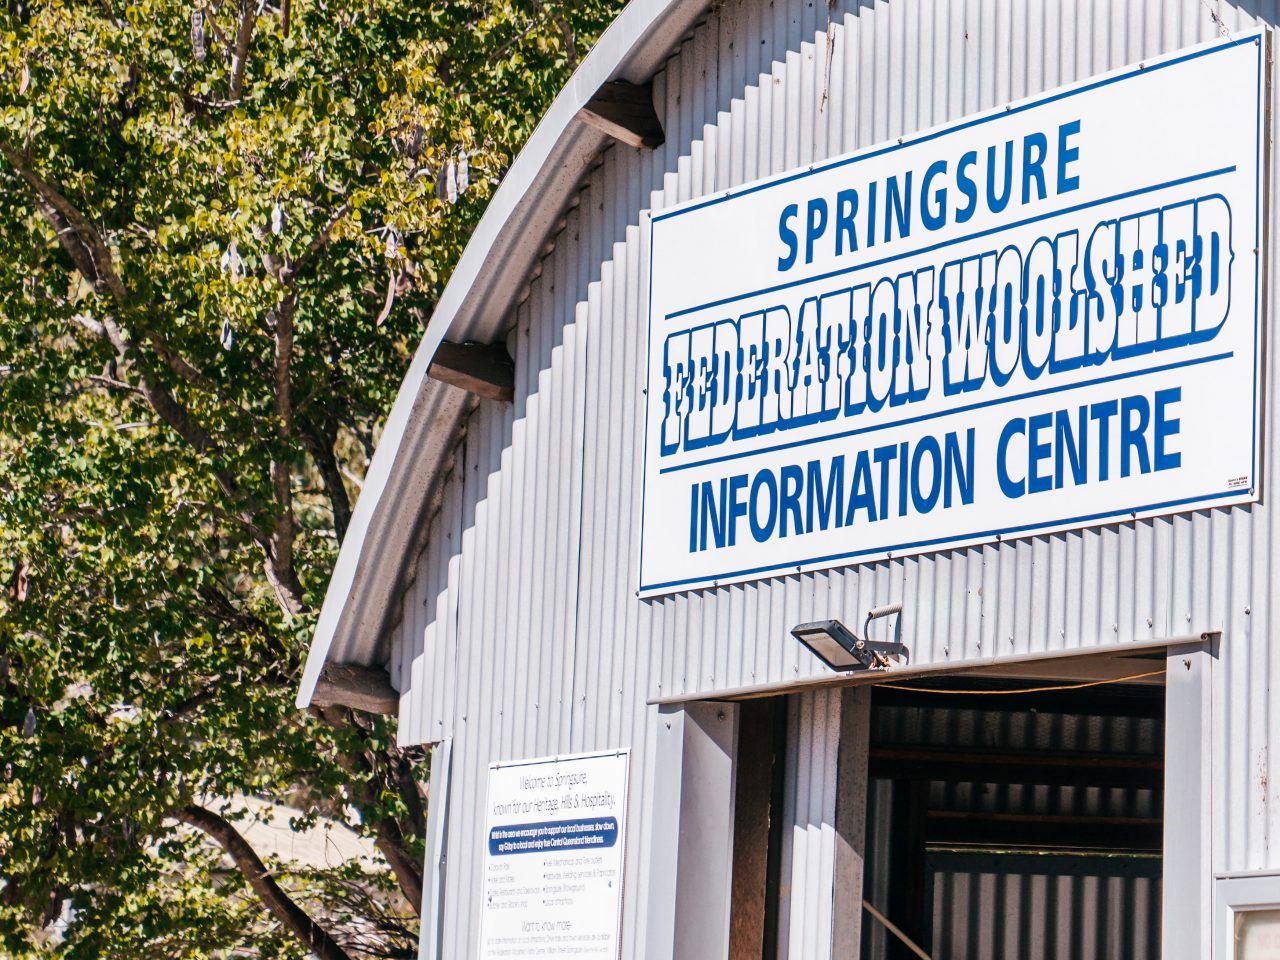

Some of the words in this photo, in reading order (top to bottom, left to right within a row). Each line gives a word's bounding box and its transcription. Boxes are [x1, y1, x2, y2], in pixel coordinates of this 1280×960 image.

[777, 120, 1081, 272] SPRINGSURE
[660, 265, 934, 457] FEDERATION
[939, 193, 1235, 397] WOOLSHED
[689, 427, 976, 553] INFORMATION
[996, 386, 1182, 499] CENTRE
[493, 800, 512, 815] known
[512, 798, 521, 814] for
[522, 801, 533, 813] our
[561, 793, 572, 808] Hills
[573, 793, 579, 808] &
[519, 775, 545, 789] Welcome
[547, 776, 553, 787] to
